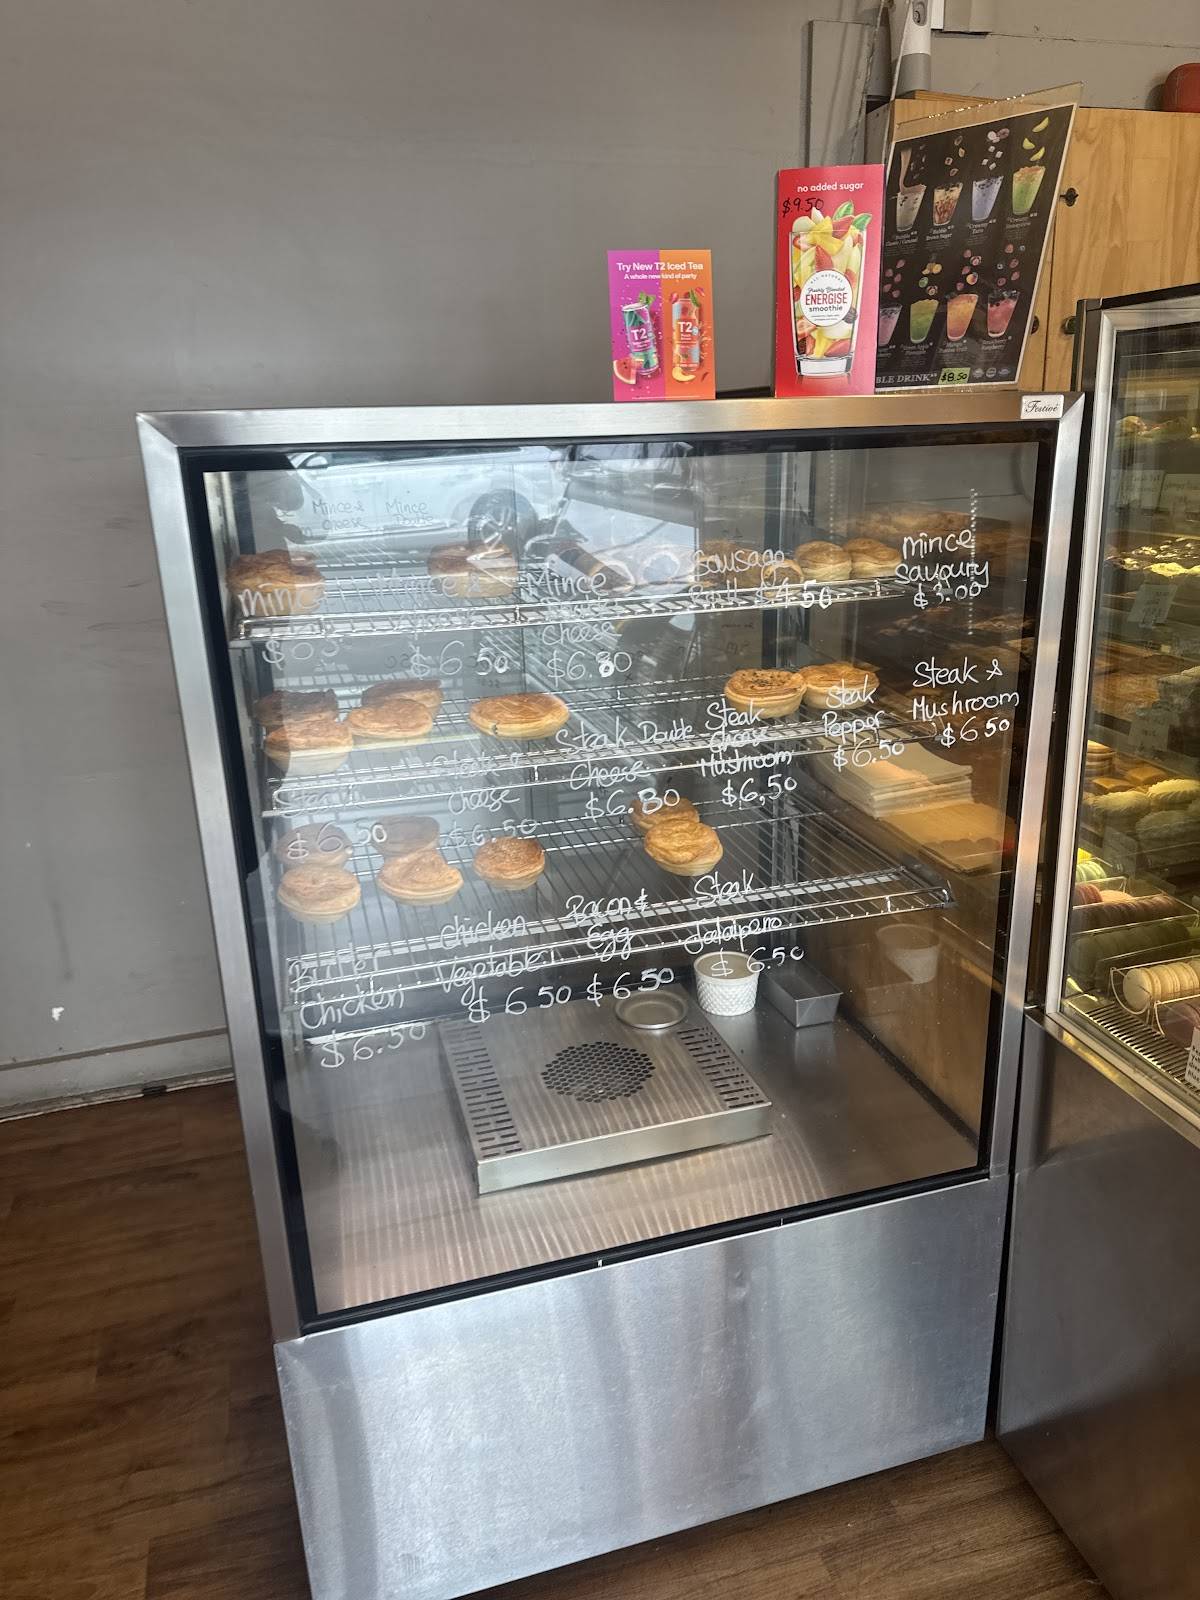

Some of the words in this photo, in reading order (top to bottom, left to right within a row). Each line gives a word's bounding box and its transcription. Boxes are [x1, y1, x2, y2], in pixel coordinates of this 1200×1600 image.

[810, 182, 838, 192] added
[839, 182, 864, 192] sugar
[616, 262, 632, 272] Try
[632, 262, 653, 271] New
[654, 262, 666, 271] T2
[667, 262, 687, 271] Iced
[687, 261, 704, 270] Tea
[805, 293, 848, 306] ENERGISE
[809, 304, 843, 312] smoothie
[630, 328, 648, 341] T2
[678, 321, 693, 333] T2
[896, 373, 931, 383] DRINK
[941, 372, 968, 383] $8.50
[526, 562, 609, 597] Mince
[912, 656, 979, 689] Steak
[825, 674, 876, 709] Steak
[705, 698, 765, 732] Steak
[912, 690, 1020, 722] Mushroom
[555, 716, 629, 756] Steak
[694, 869, 756, 908] Steak
[586, 923, 637, 963] Egg
